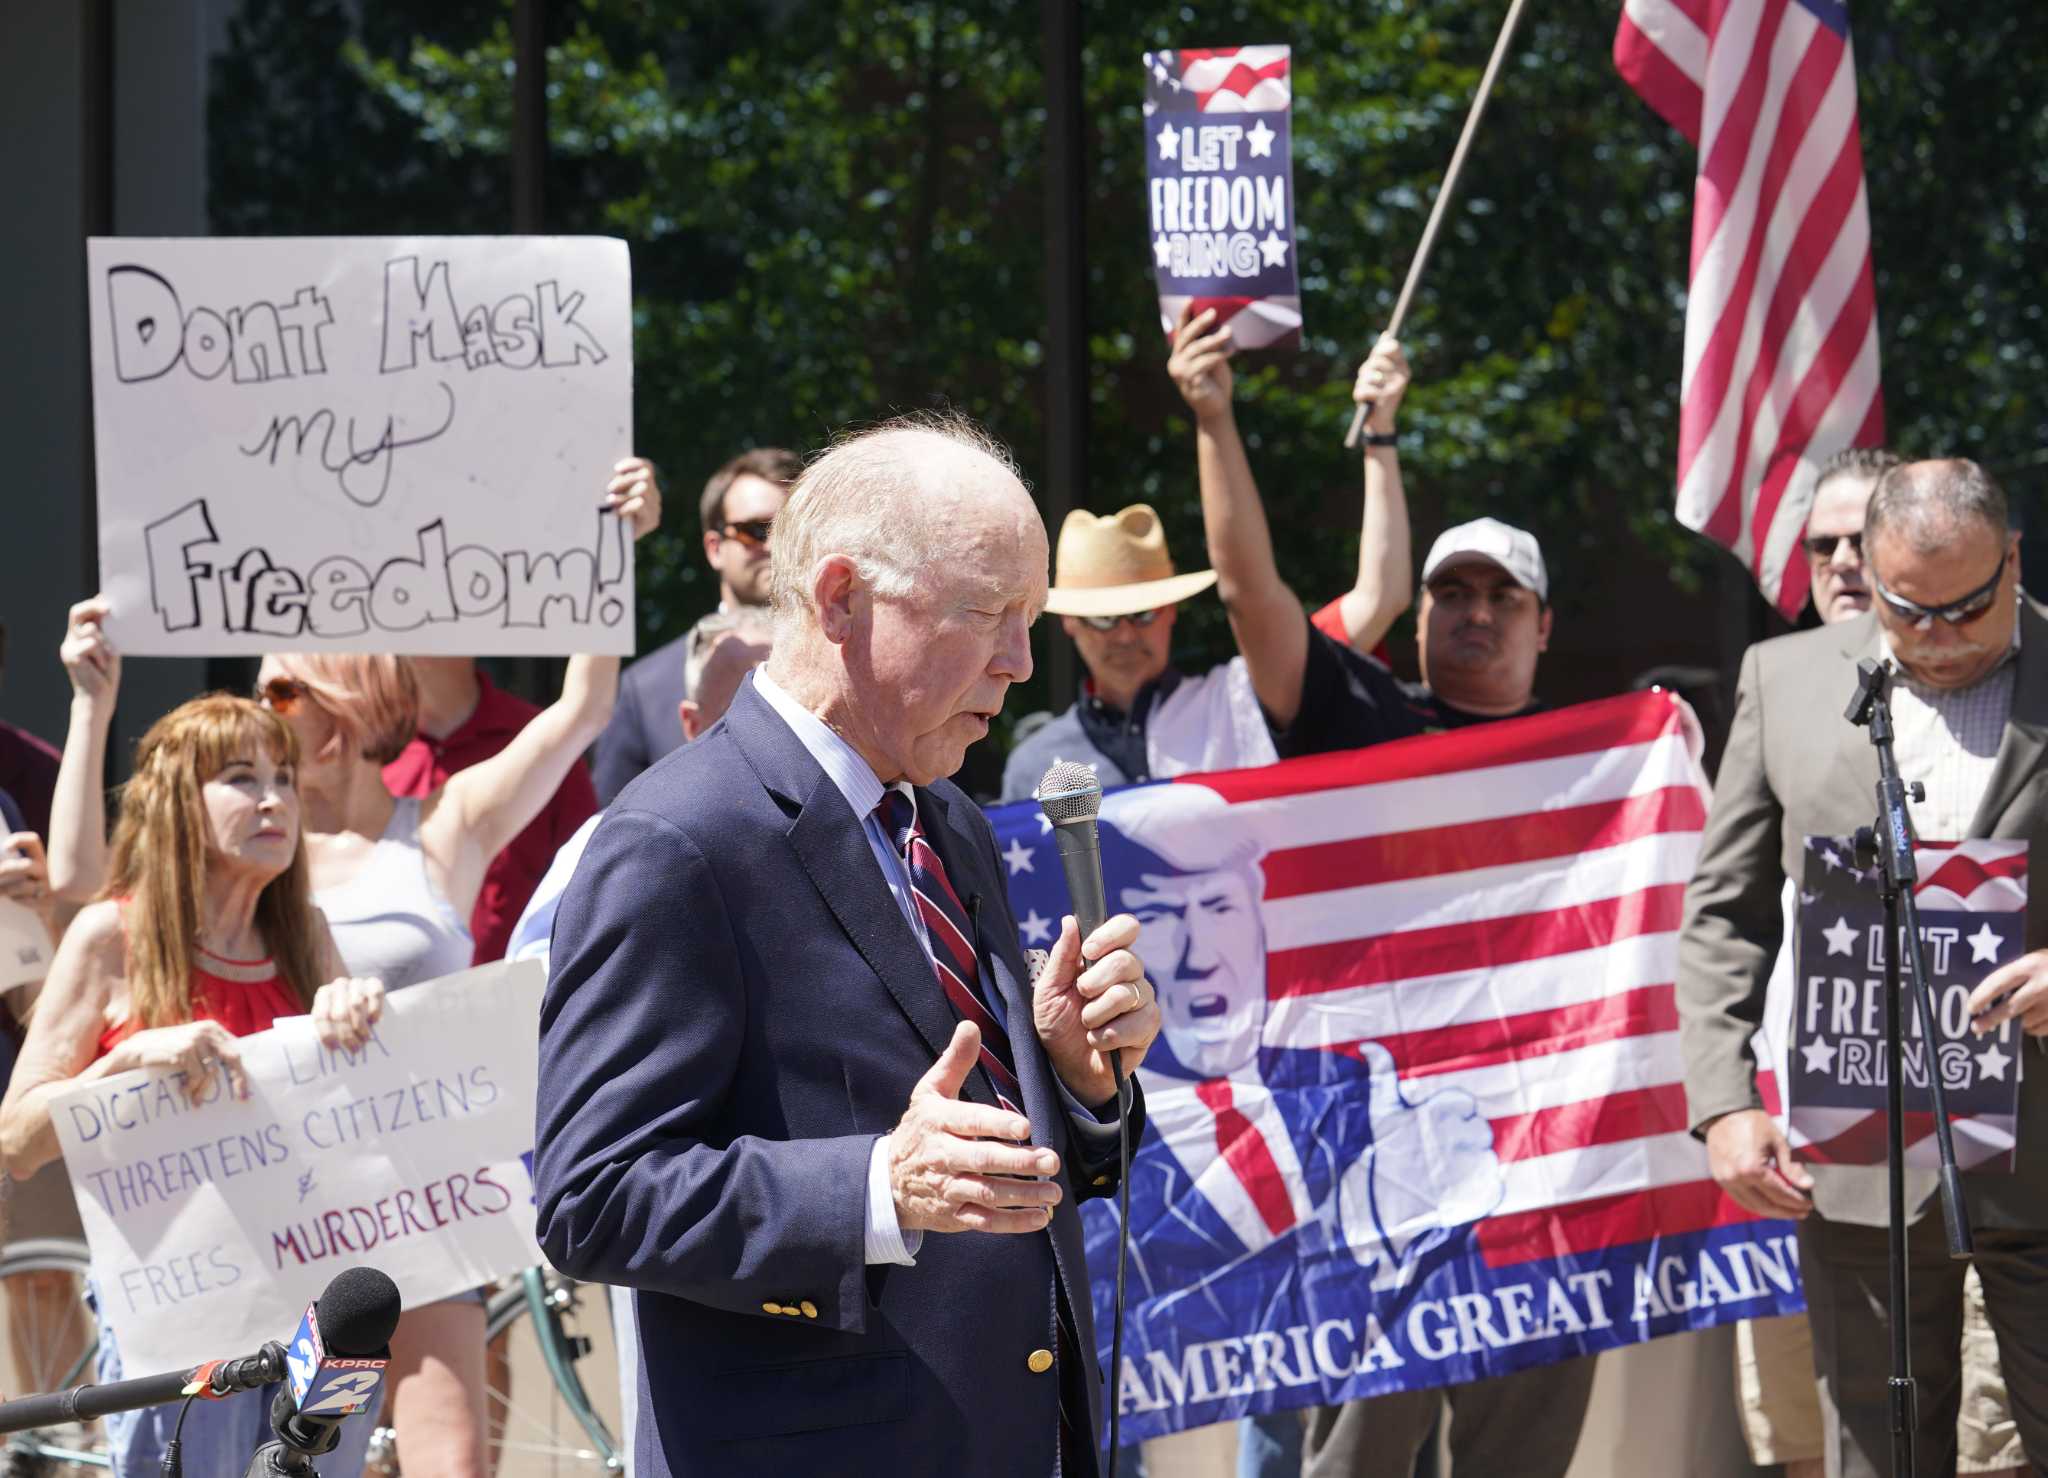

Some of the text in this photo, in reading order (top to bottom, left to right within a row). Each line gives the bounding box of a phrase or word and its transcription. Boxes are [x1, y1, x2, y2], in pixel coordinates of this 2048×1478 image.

[1181, 125, 1243, 172] LET
[1151, 175, 1285, 232] FREEDOM
[1169, 231, 1261, 278] RING
[107, 256, 608, 384] Dont Mask
[240, 381, 455, 508] my
[145, 498, 626, 637] Freedom!
[86, 1065, 497, 1217] THREATENS CITIZENS
[119, 1246, 241, 1313] FREES
[1118, 1235, 1804, 1416] AMERICA GREAT AGAIN!
[301, 1370, 380, 1413] 2
[324, 1360, 387, 1369] KPRC
